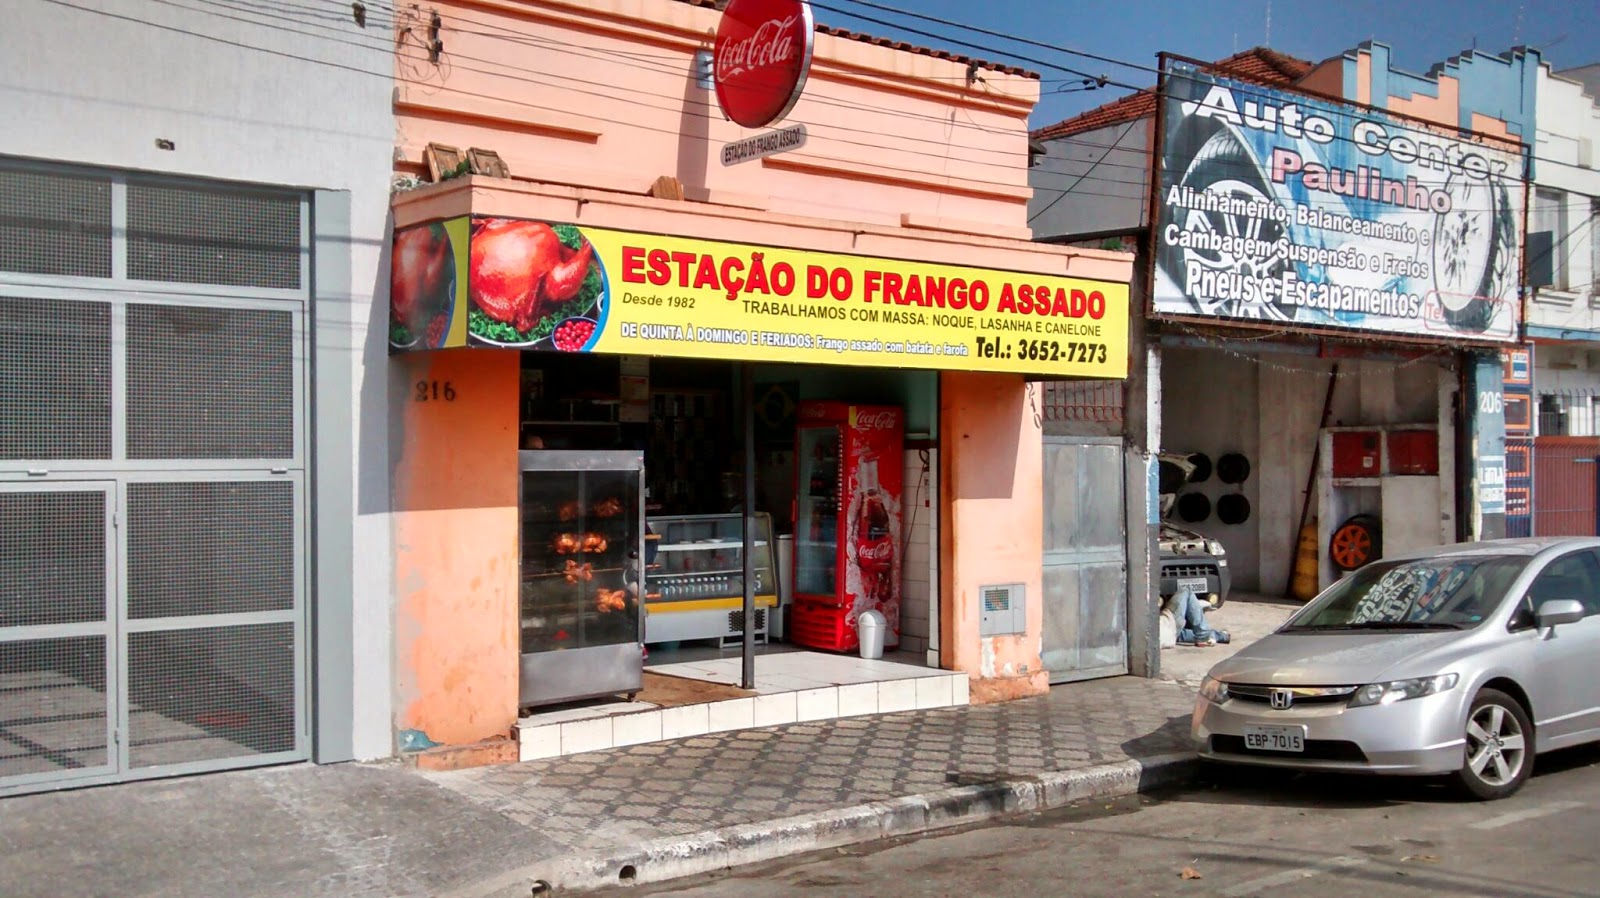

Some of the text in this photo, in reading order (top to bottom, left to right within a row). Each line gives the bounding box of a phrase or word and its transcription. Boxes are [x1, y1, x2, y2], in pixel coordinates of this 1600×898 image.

[748, 139, 756, 156] DO
[757, 134, 778, 153] FRANGO
[779, 128, 800, 148] ASSADO
[1194, 85, 1508, 183] Auto Center
[1271, 145, 1452, 215] Paulinho
[1165, 184, 1430, 246] Alinhamento, Balanceamento e
[1276, 238, 1367, 271] Suspensão
[1370, 254, 1380, 273] e
[1382, 252, 1429, 279] Freios
[622, 245, 1106, 320] ESTAÇÃO DO FRANGO ASSADO
[622, 292, 696, 309] Desde 1982
[1184, 259, 1420, 319] Pneus e Escapamentos
[742, 299, 1101, 337] TRABALHAMOS COM MASSA: NOQUE, LASANHA E CANELONE
[621, 321, 638, 338] DE
[640, 323, 684, 341] QUINTA
[697, 326, 749, 345] DOMINGO
[751, 331, 758, 345] E
[760, 331, 815, 349] FERIADOS:
[816, 335, 849, 353] Frango
[850, 338, 882, 352] assado
[885, 341, 904, 353] com
[906, 340, 934, 355] batata
[936, 344, 942, 355] e
[943, 342, 969, 356] farofa
[976, 336, 1107, 364] Tel.: 3652-7273
[415, 380, 457, 402] 216
[1480, 391, 1502, 414] 206
